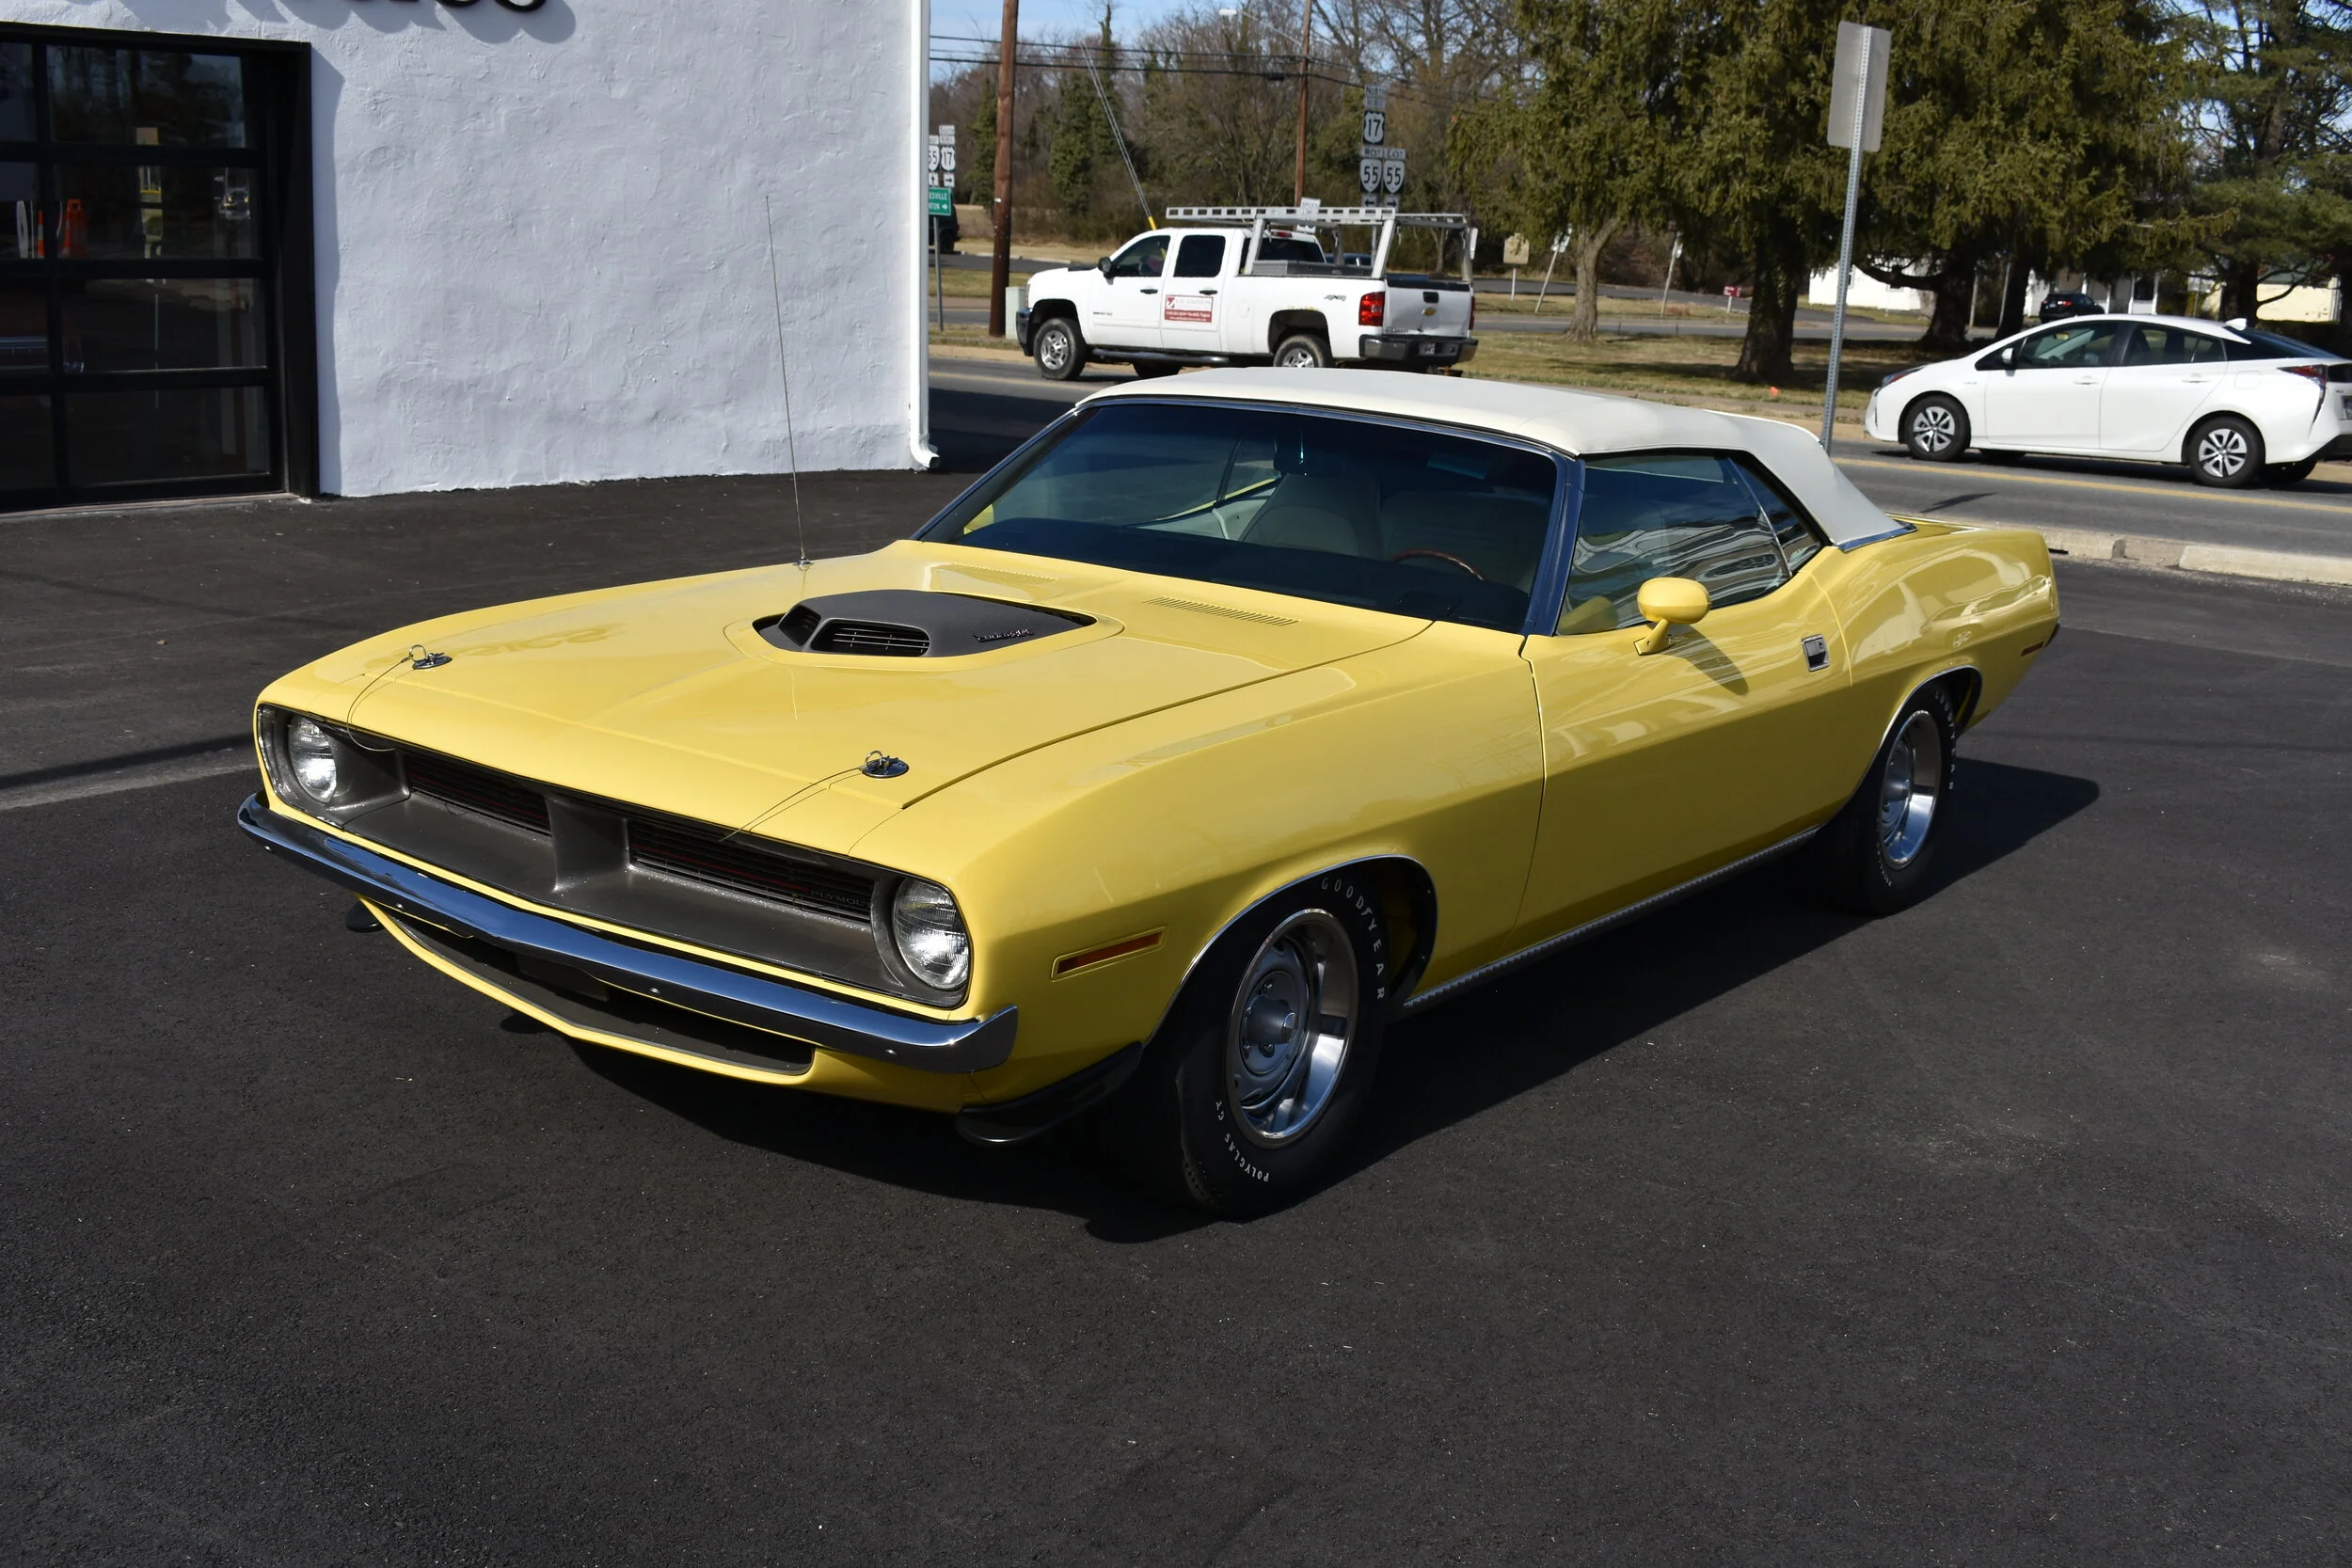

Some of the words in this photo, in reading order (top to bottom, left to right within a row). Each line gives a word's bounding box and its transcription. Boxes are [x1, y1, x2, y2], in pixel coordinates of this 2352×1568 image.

[1368, 119, 1381, 137] 17
[944, 151, 952, 166] 17
[1387, 149, 1403, 158] EAST
[1363, 166, 1378, 184] 55
[1387, 167, 1401, 186] 55
[1321, 877, 1386, 1000] GOODYEAR
[1224, 1132, 1270, 1182] POLYGLAS
